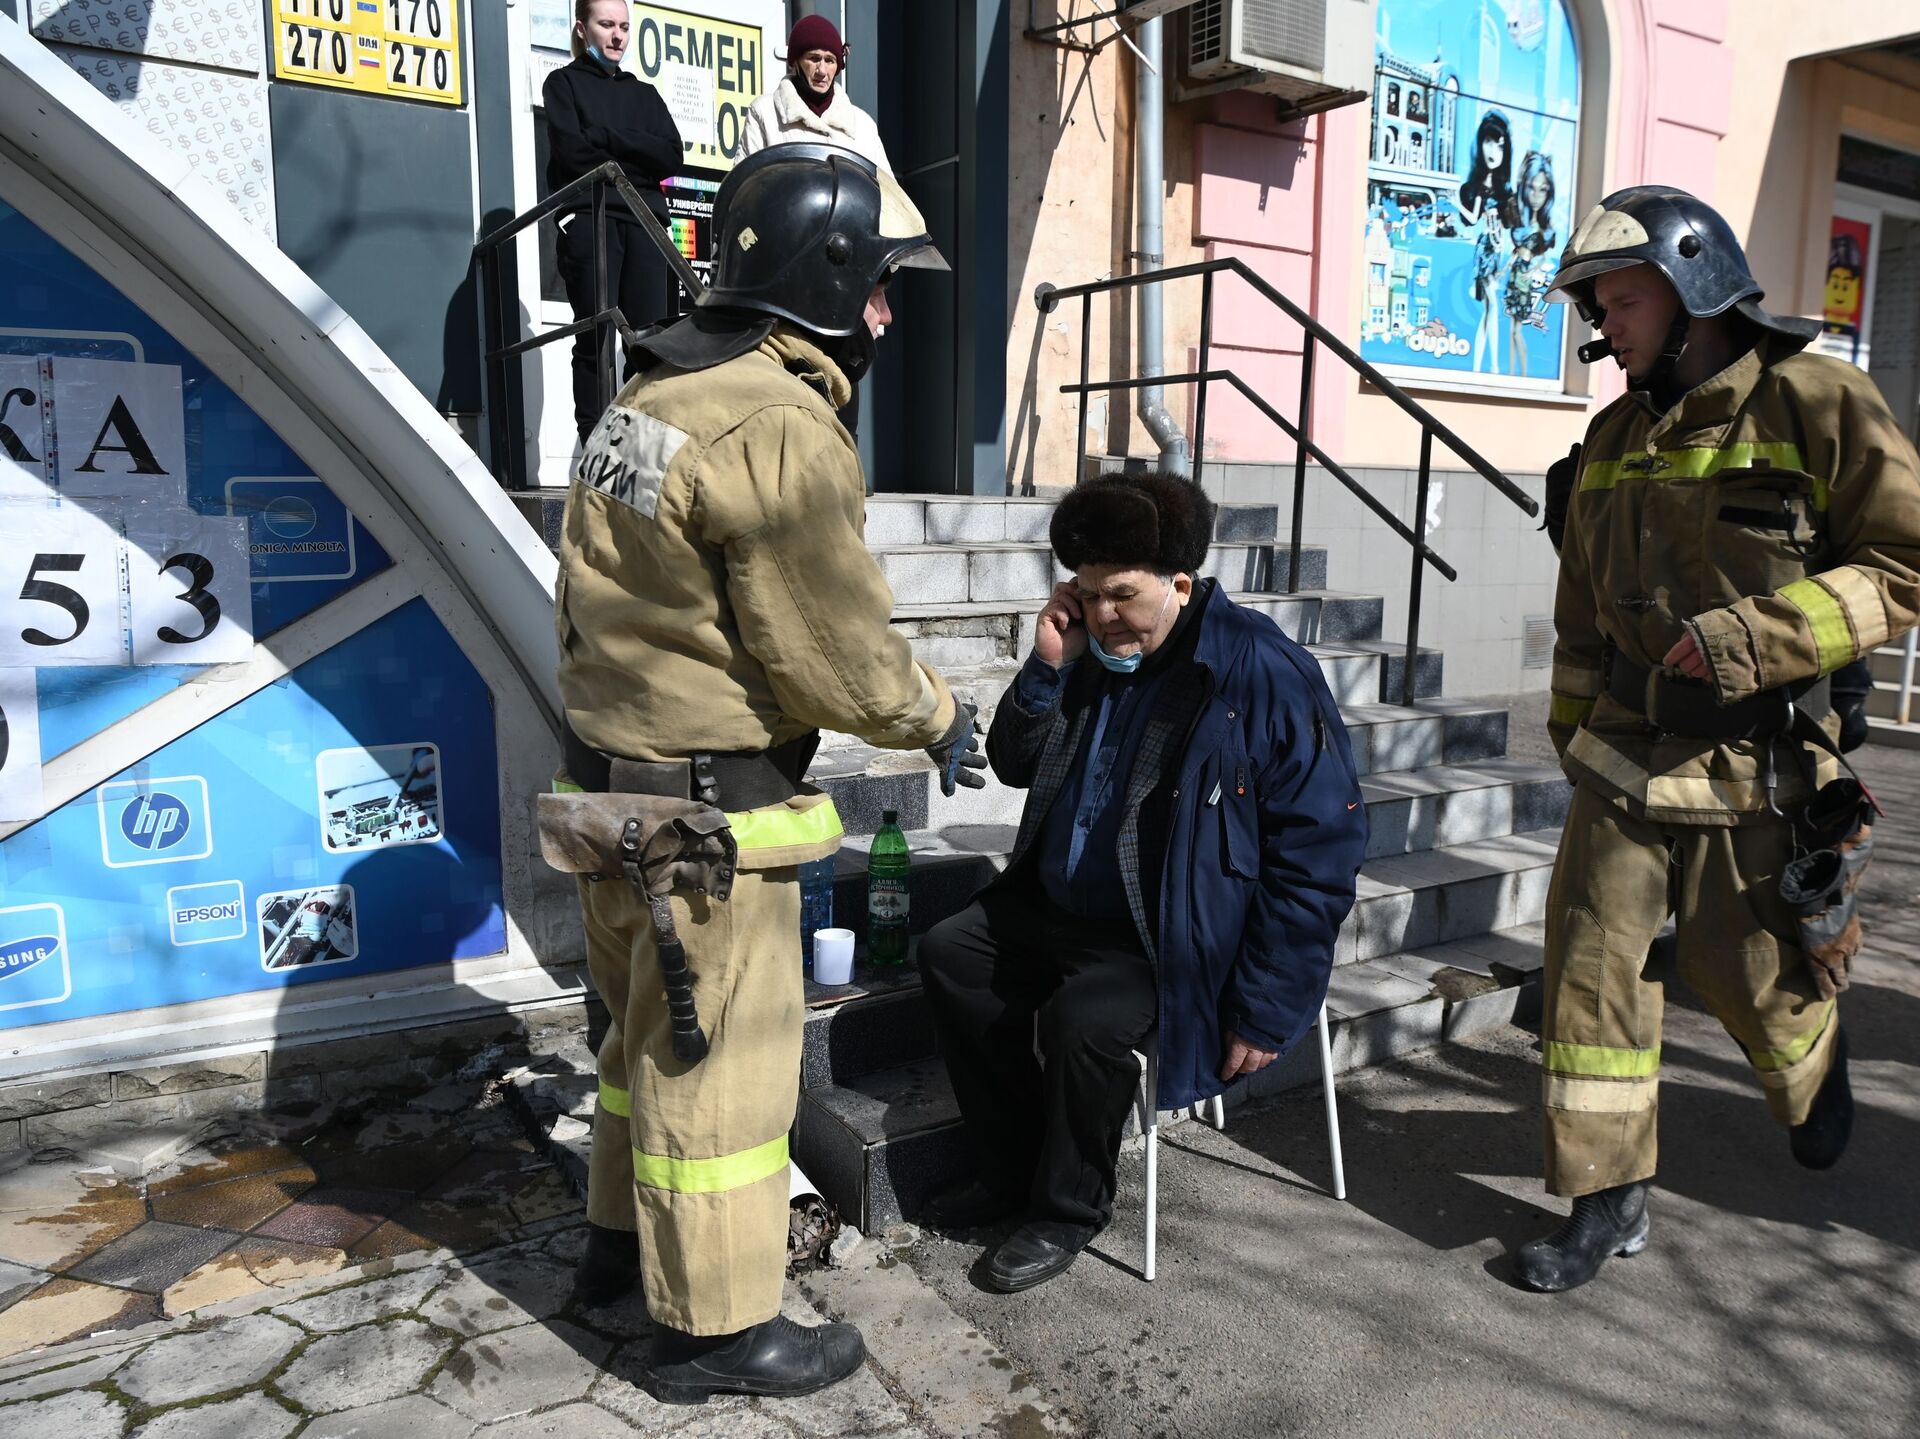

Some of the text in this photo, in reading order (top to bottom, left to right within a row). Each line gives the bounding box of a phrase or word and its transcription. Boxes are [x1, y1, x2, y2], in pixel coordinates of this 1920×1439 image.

[288, 23, 347, 75] 270
[391, 41, 447, 90] 270
[638, 17, 756, 96] ОБМЕН
[1407, 329, 1471, 359] duplo
[249, 541, 346, 554] ONICA MINOLTA
[132, 793, 180, 851] hp
[176, 904, 235, 923] EPSON
[0, 947, 46, 969] SUNG
